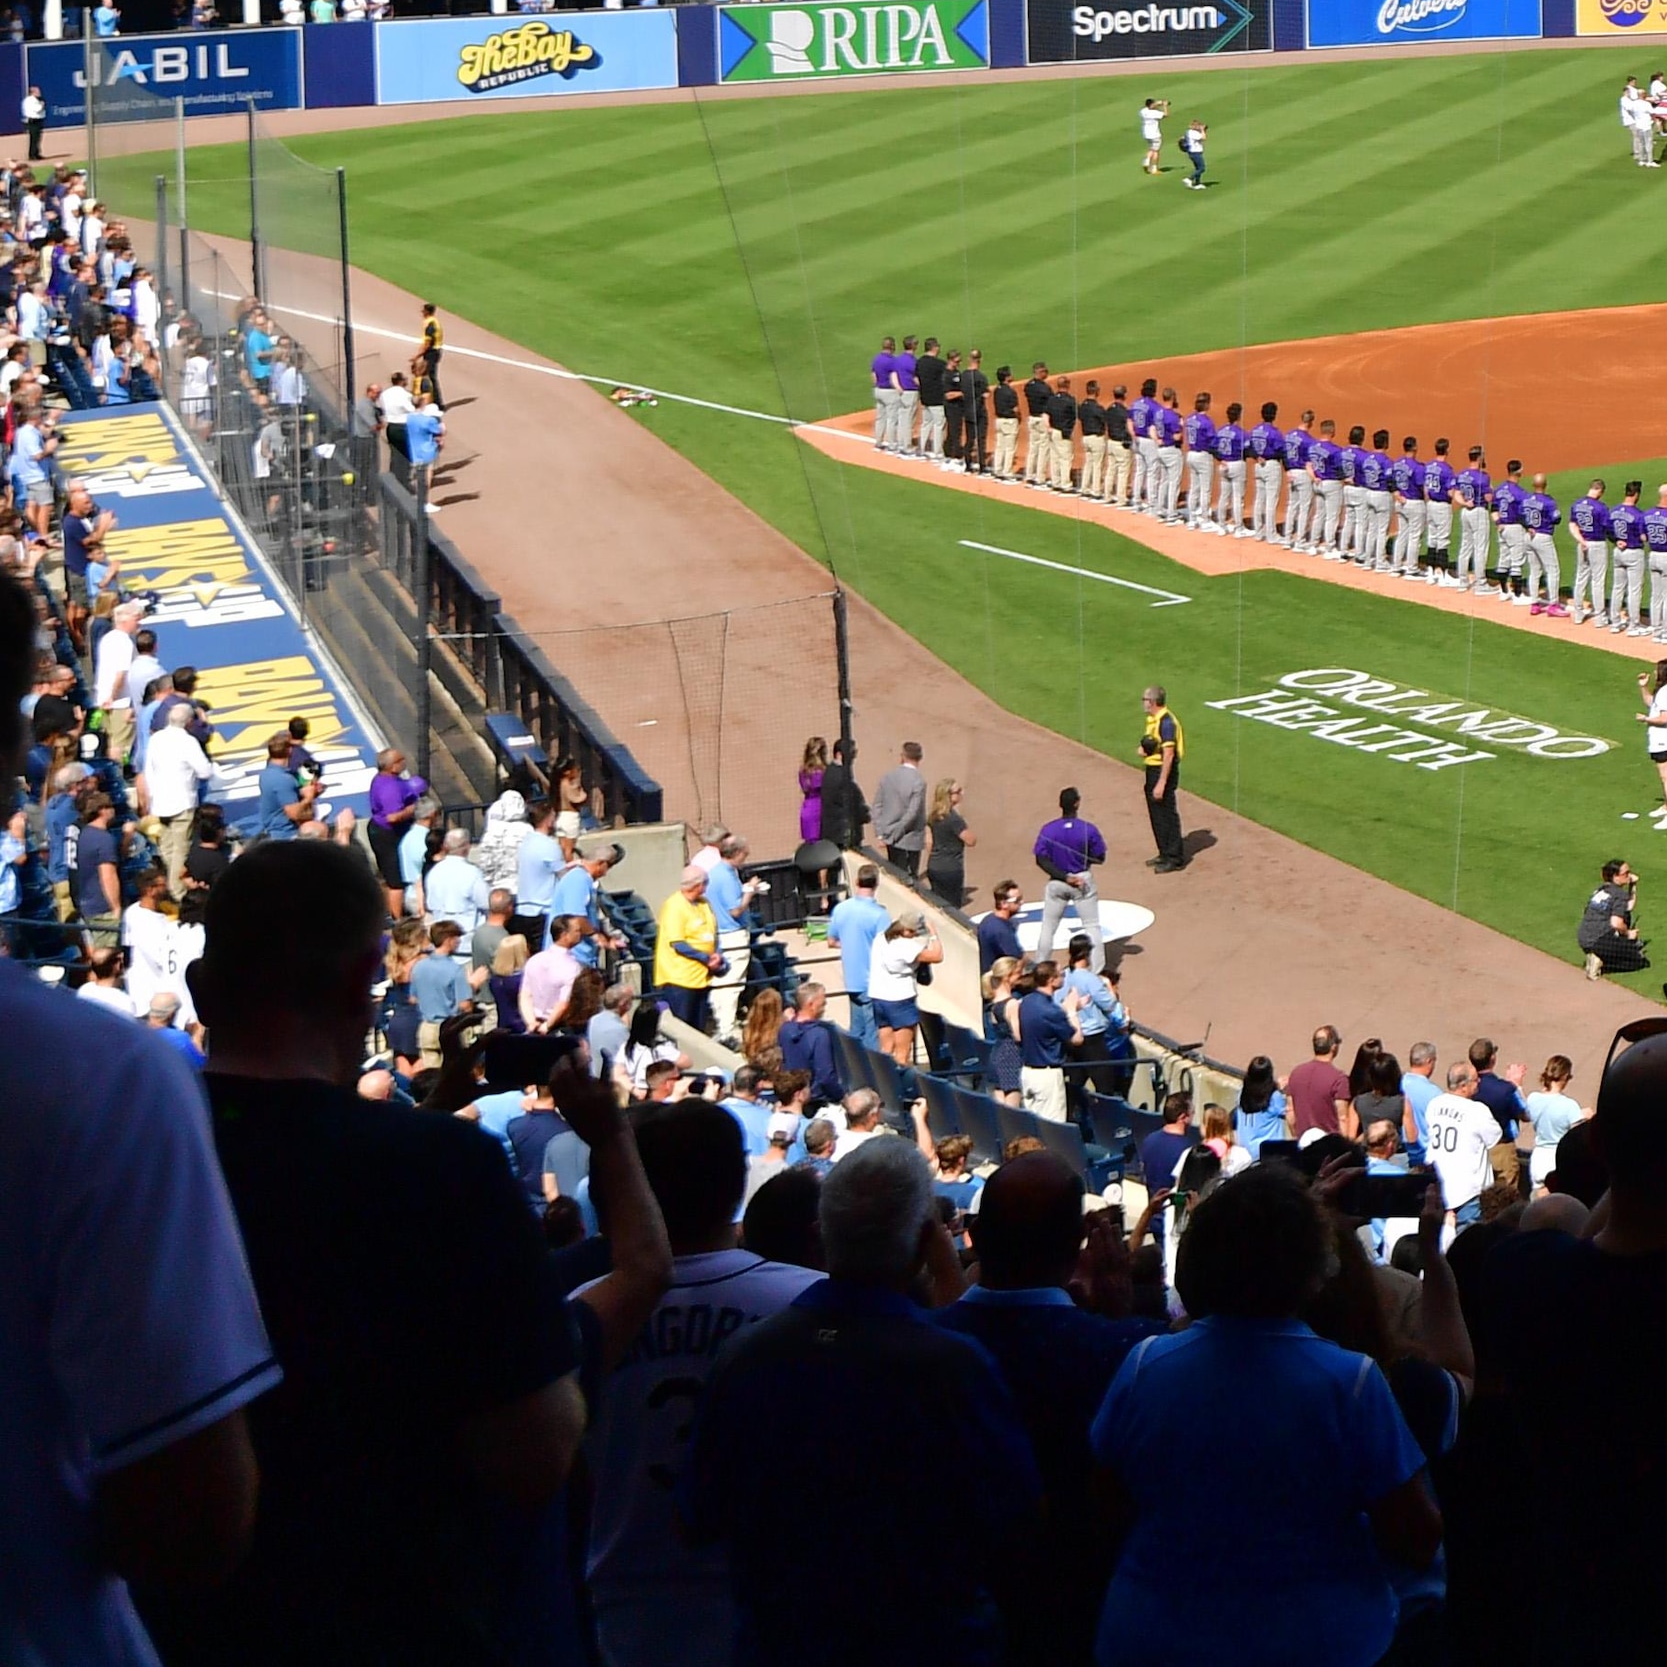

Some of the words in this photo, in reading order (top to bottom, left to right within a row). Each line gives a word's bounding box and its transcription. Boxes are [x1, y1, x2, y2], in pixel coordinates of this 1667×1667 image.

[818, 3, 956, 71] RIPA
[1073, 3, 1218, 43] Spectrum
[72, 43, 250, 89] JABIL
[478, 62, 550, 90] REPUBLIC
[1647, 524, 1667, 545] 25
[1201, 688, 1499, 771] HEALTH
[1277, 666, 1612, 760] ORLANDO
[1432, 1123, 1458, 1153] 30
